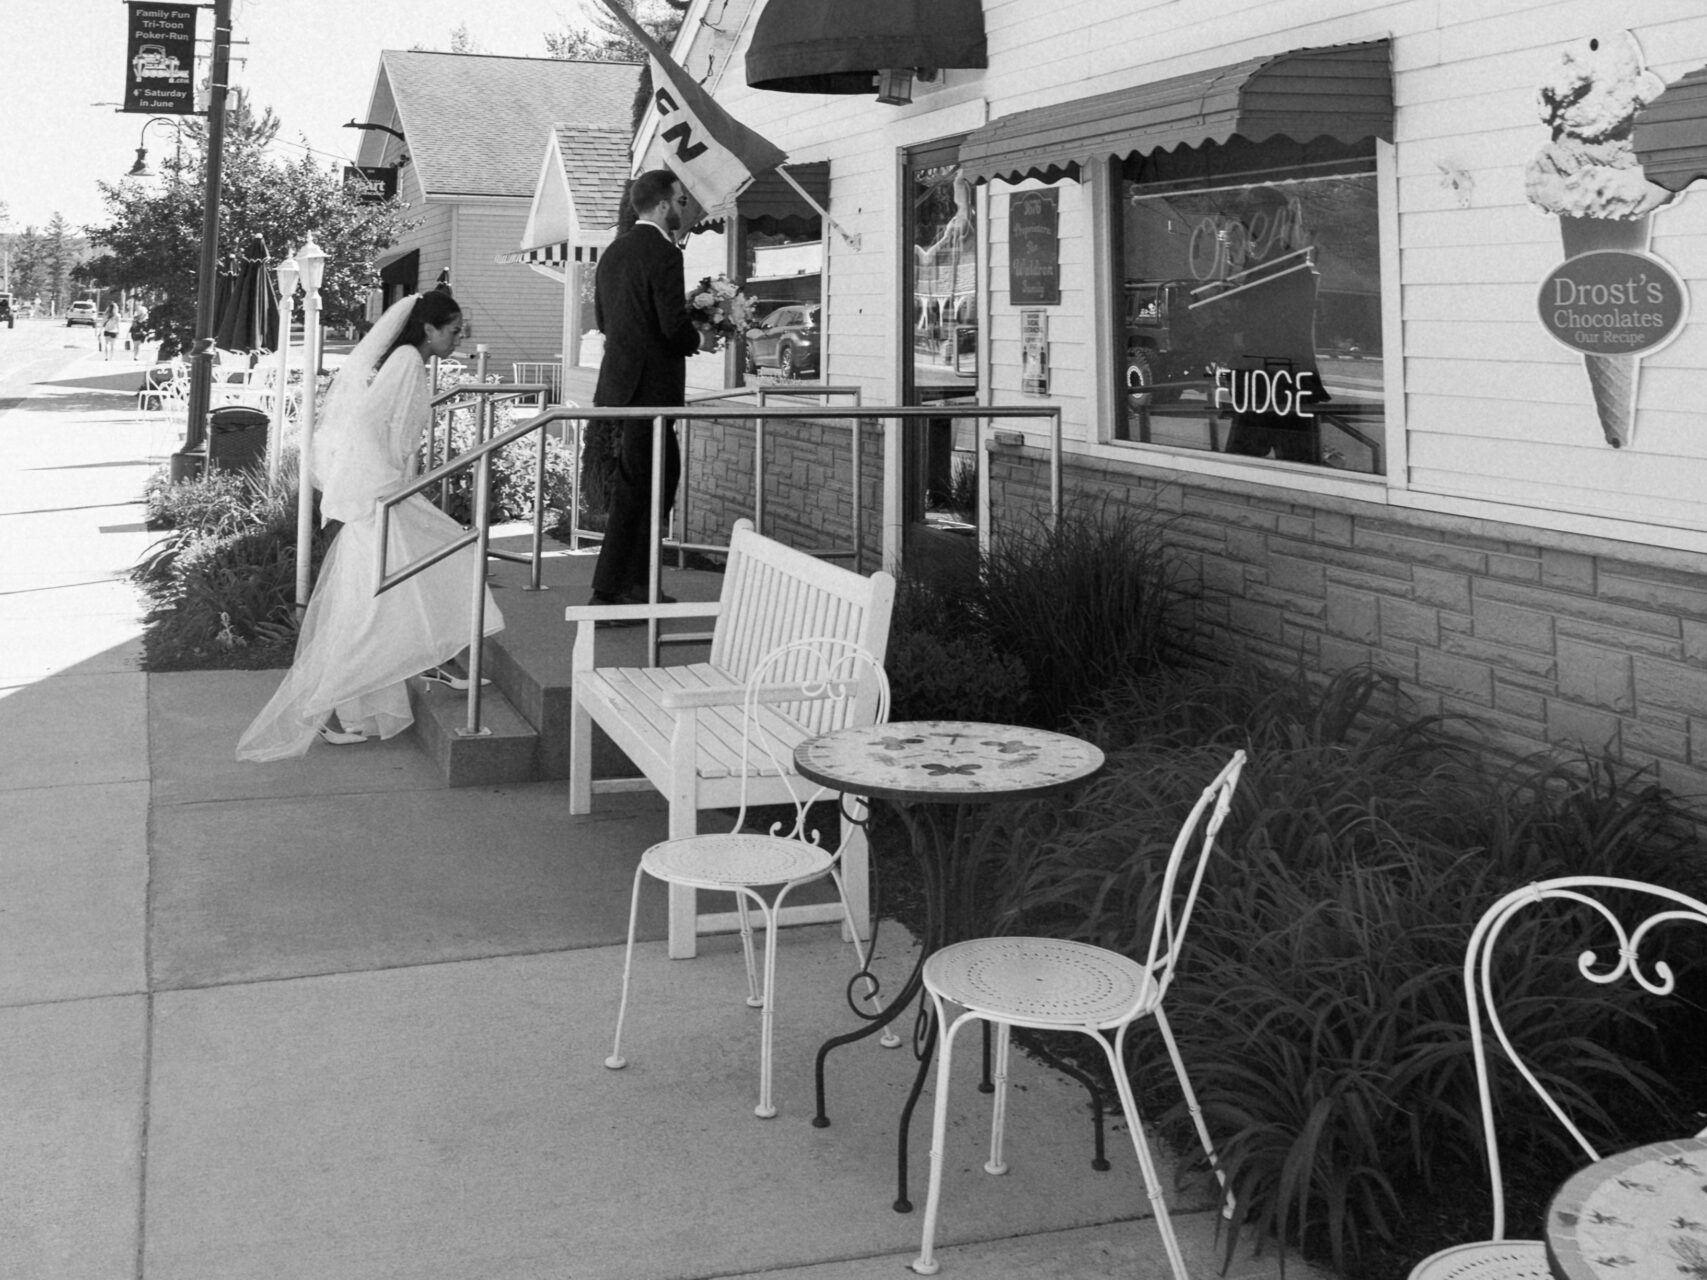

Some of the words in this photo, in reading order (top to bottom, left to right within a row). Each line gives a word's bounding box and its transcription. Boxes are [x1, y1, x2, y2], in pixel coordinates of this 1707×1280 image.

[136, 9, 170, 19] Family
[142, 21, 184, 29] Tri-Toon
[135, 31, 189, 40] Poker-Run
[144, 89, 187, 98] Saturday
[1553, 273, 1664, 306] Drost's
[1553, 308, 1664, 328] Chocolates
[1575, 330, 1600, 343] Our
[1603, 330, 1645, 347] Recipe
[1215, 369, 1315, 418] FUDGE
